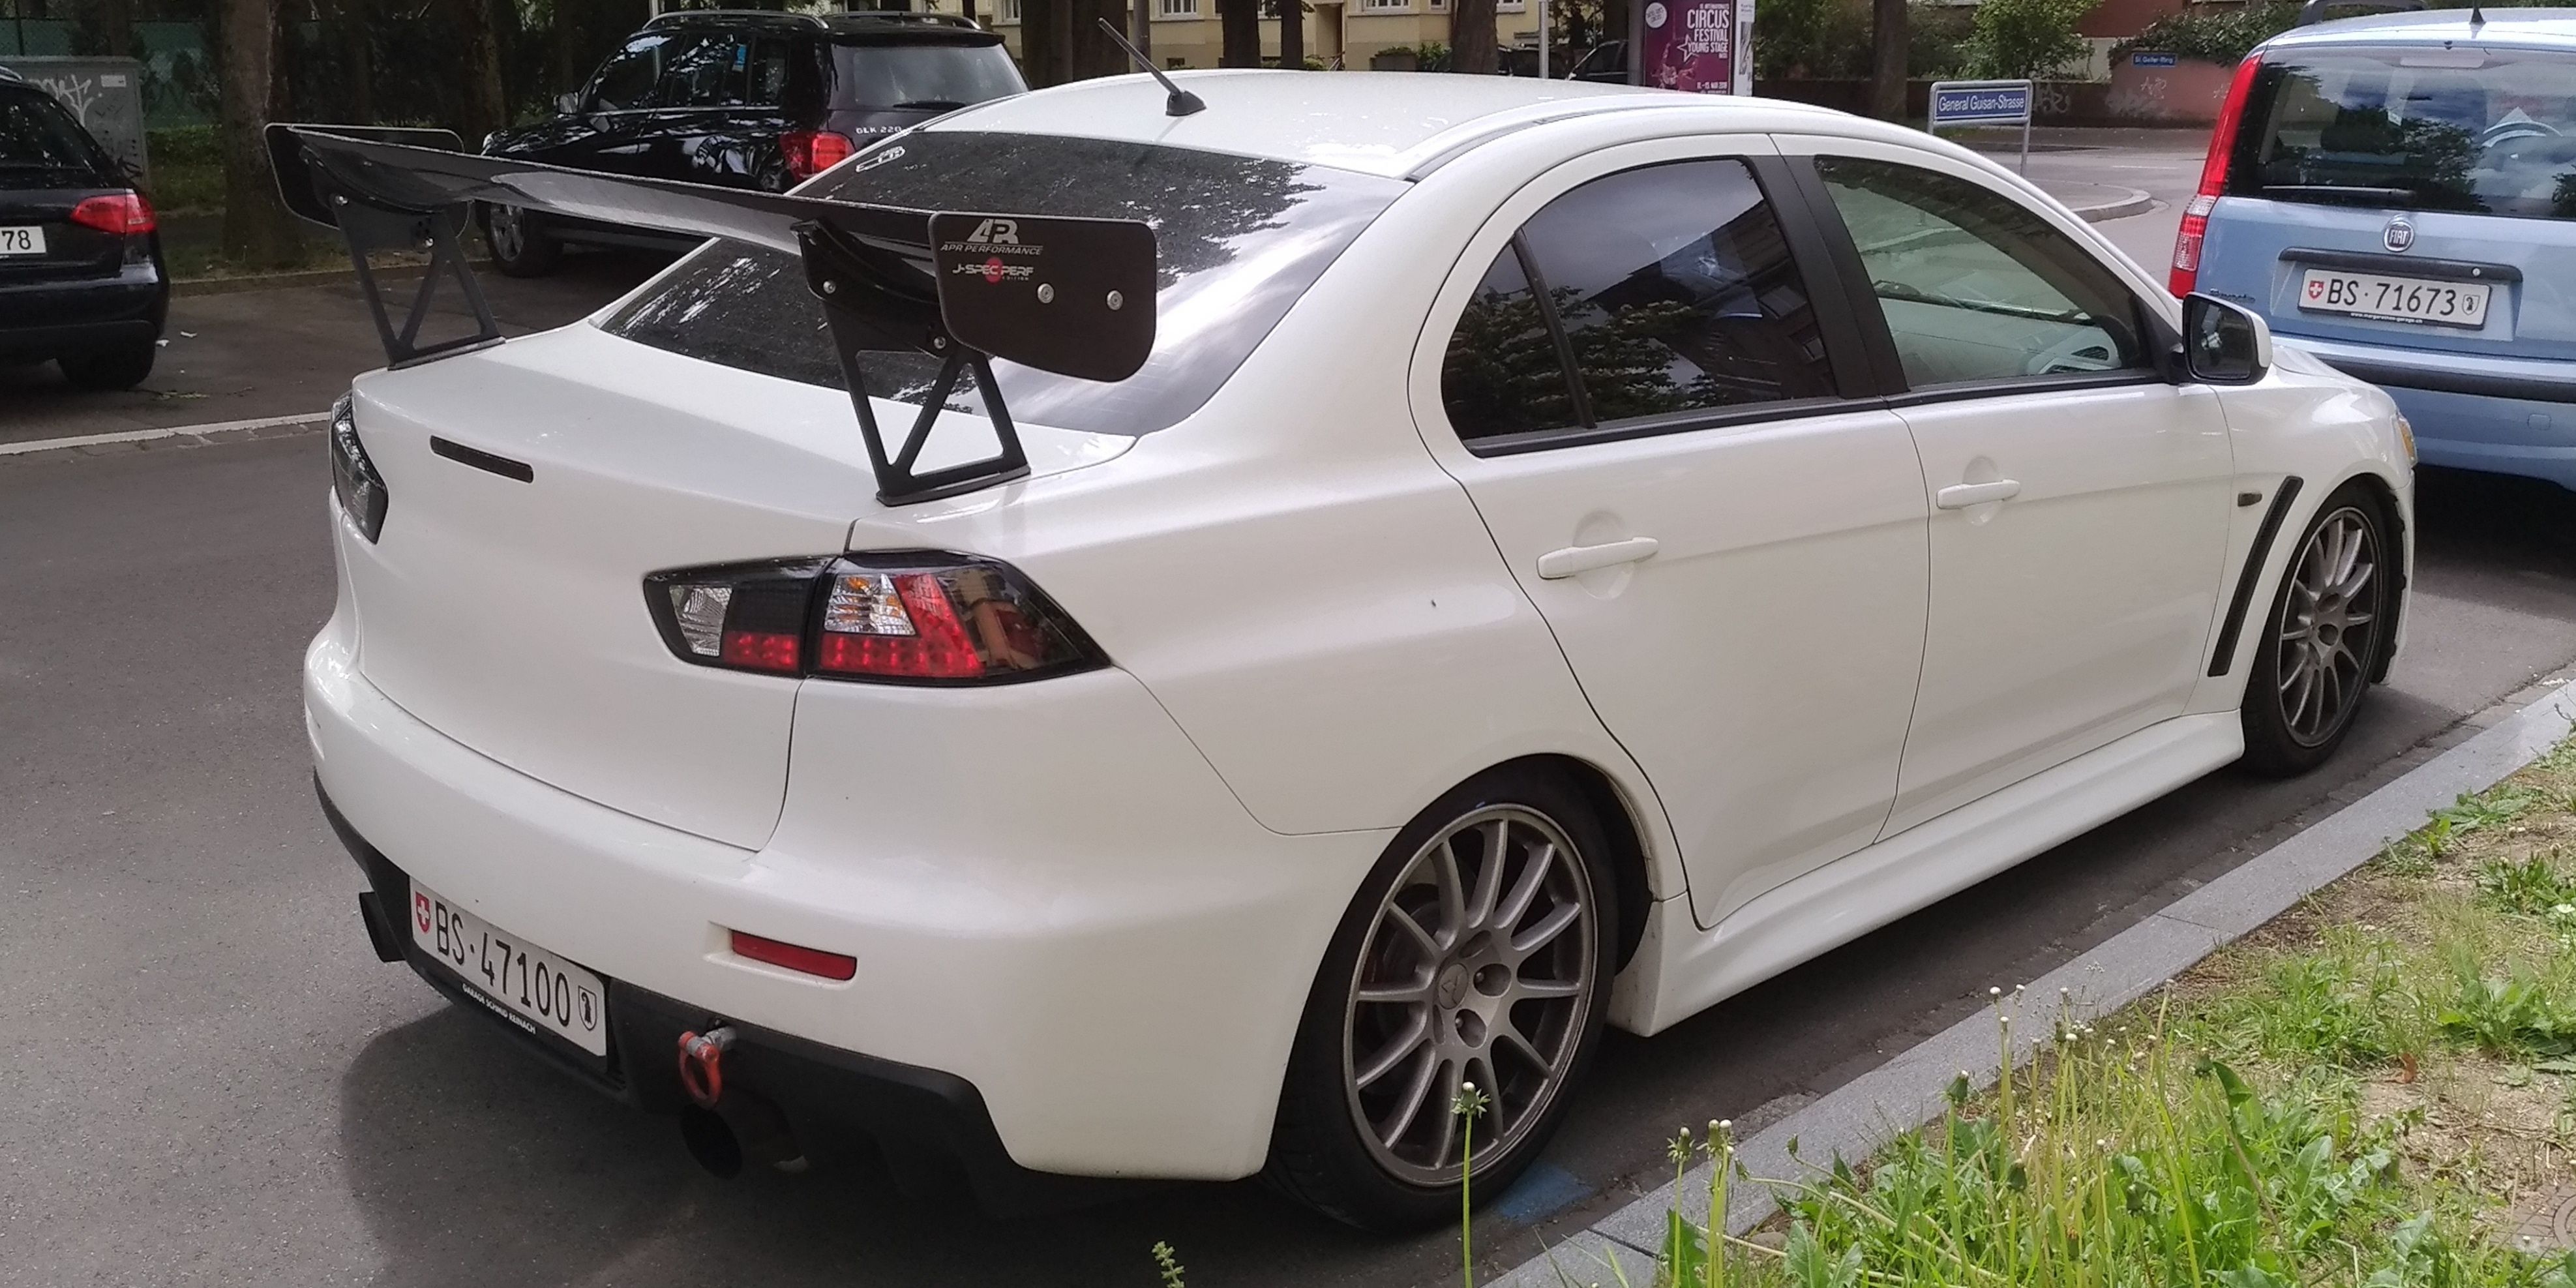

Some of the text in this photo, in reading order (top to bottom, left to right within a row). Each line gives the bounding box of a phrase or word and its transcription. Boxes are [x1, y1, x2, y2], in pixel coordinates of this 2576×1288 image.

[1687, 9, 1730, 29] CIRCUS
[1694, 29, 1728, 42] FESTIVAL
[1688, 42, 1728, 53] YOUNG STAGE
[1938, 94, 2024, 112] General Guisan-Strasse
[2388, 230, 2408, 245] FIAT
[965, 245, 1043, 256] PERFORMANCE
[1000, 265, 1034, 276] PERF
[462, 983, 485, 1005] GARAGE
[509, 1012, 536, 1035] REINACH
